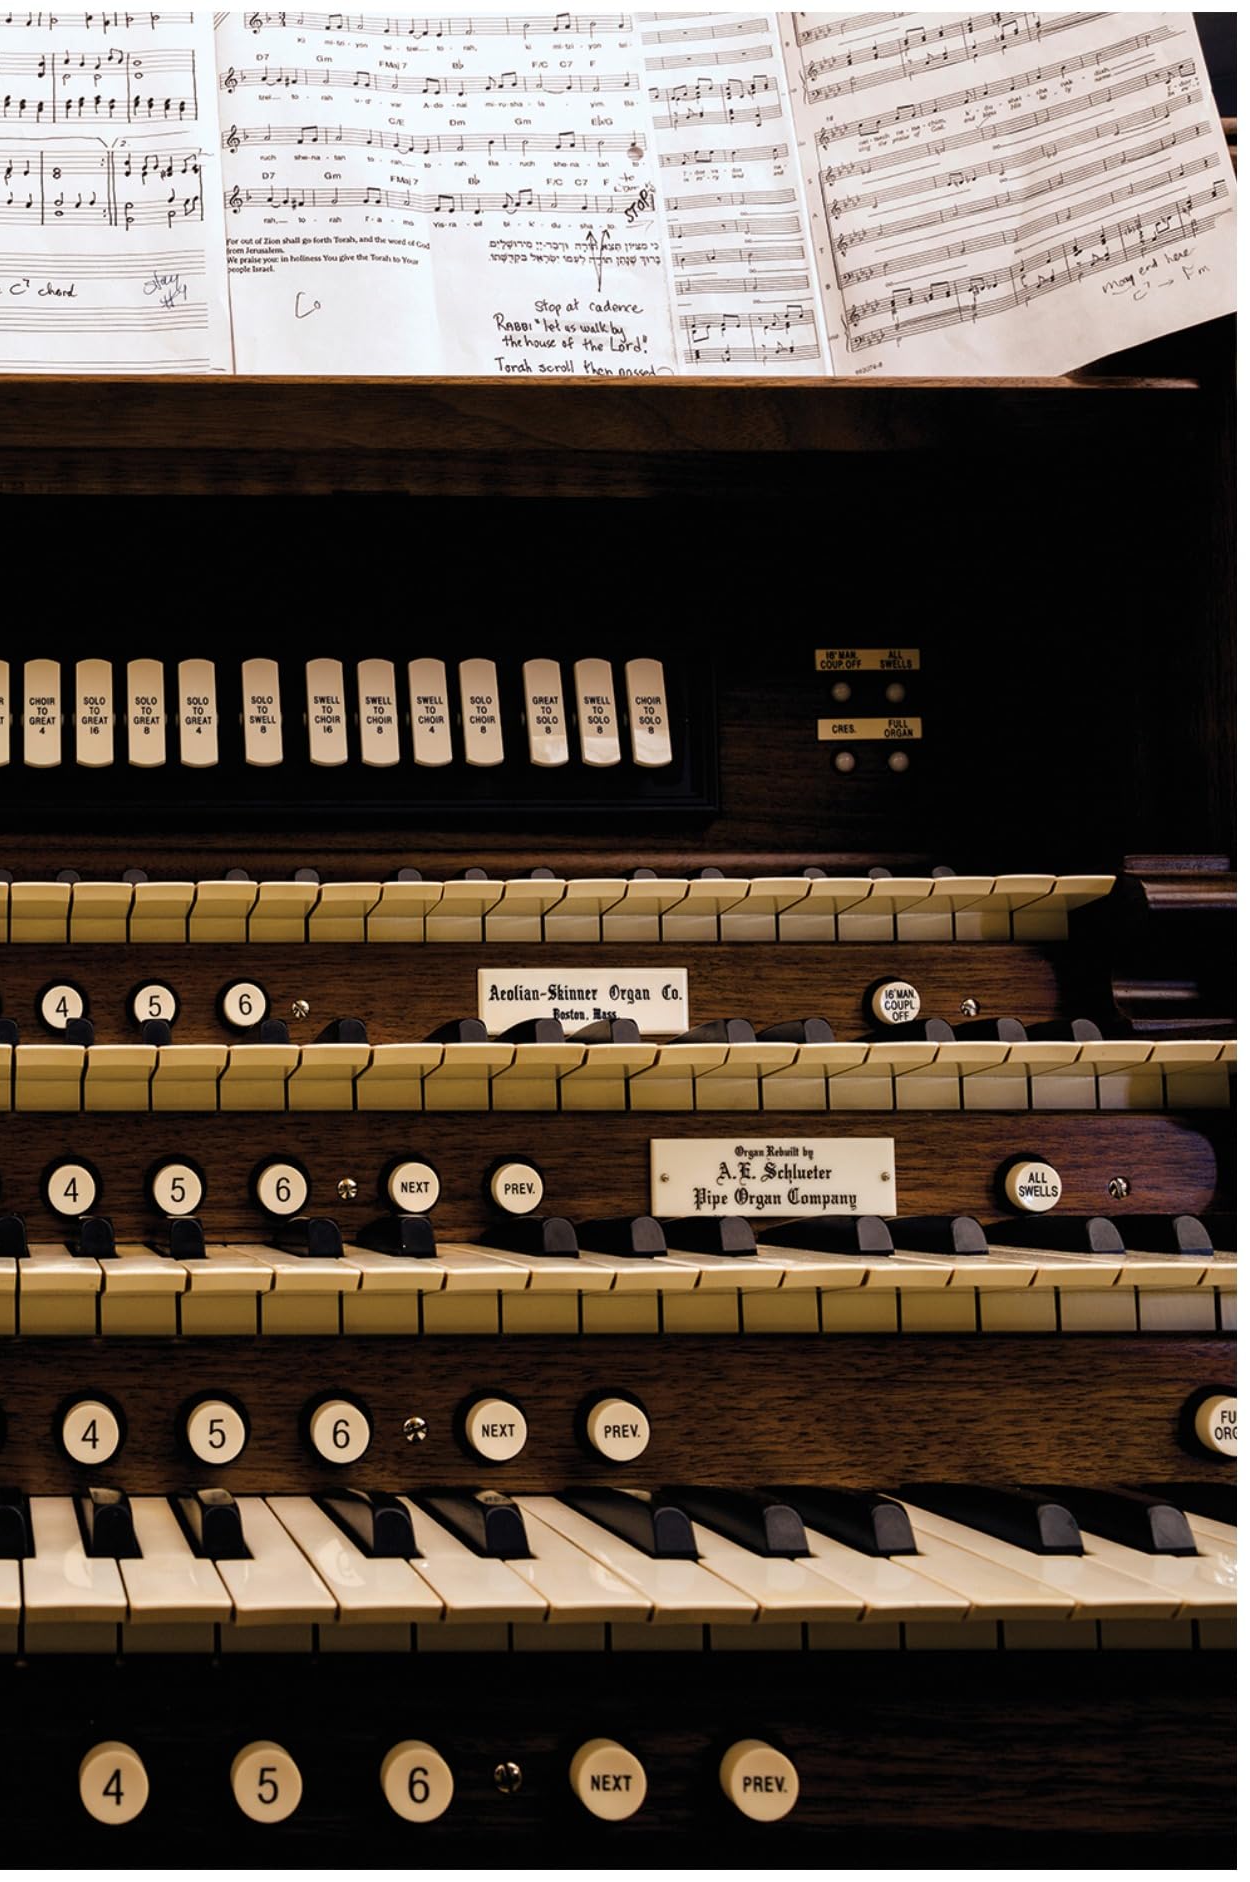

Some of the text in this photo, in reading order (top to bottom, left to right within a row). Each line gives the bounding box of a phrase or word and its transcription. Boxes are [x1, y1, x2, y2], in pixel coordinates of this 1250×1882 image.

[302, 238, 312, 246] go
[240, 257, 261, 265] praise
[370, 254, 391, 262] Torah
[1139, 259, 1158, 275] end
[38, 283, 78, 297] chord
[535, 298, 644, 316] Stop at cadence
[565, 324, 576, 332] us
[580, 321, 608, 333] walk
[609, 321, 626, 342] by
[502, 335, 521, 348] the
[524, 335, 556, 348] house
[562, 335, 574, 349] of
[583, 339, 603, 351] the
[494, 356, 532, 373] Torah
[539, 360, 574, 373] scroll
[888, 651, 902, 659] ALL
[845, 660, 861, 669] OFF
[880, 660, 912, 669] SWELLS
[251, 696, 273, 704] SOLO
[417, 696, 443, 704] SWELL
[257, 706, 268, 714] TO
[425, 706, 436, 714] TO
[250, 716, 276, 724] SWELL
[418, 716, 444, 724] CHOIR
[888, 720, 908, 728] FULL
[261, 725, 266, 733] 8
[832, 725, 856, 734] CRES.
[884, 729, 913, 737] ORGAN
[489, 984, 683, 1005] Aeolian-Skinner Organ Co.
[891, 1010, 911, 1020] OFF
[734, 1145, 814, 1161] Organ Rebuilt by
[761, 1161, 832, 1183] Schlueter
[1028, 1172, 1047, 1183] ALL
[400, 1181, 430, 1194] NEXT
[503, 1183, 536, 1195] PREV.
[1019, 1186, 1058, 1197] SWELLS
[693, 1188, 858, 1211] Pipe Organ Company
[333, 1419, 350, 1448] 6
[482, 1424, 515, 1437] NEXT
[605, 1425, 639, 1438] PREV.
[257, 1767, 280, 1806] 5
[591, 1775, 631, 1791] NEXT
[744, 1776, 786, 1792] PREV.
